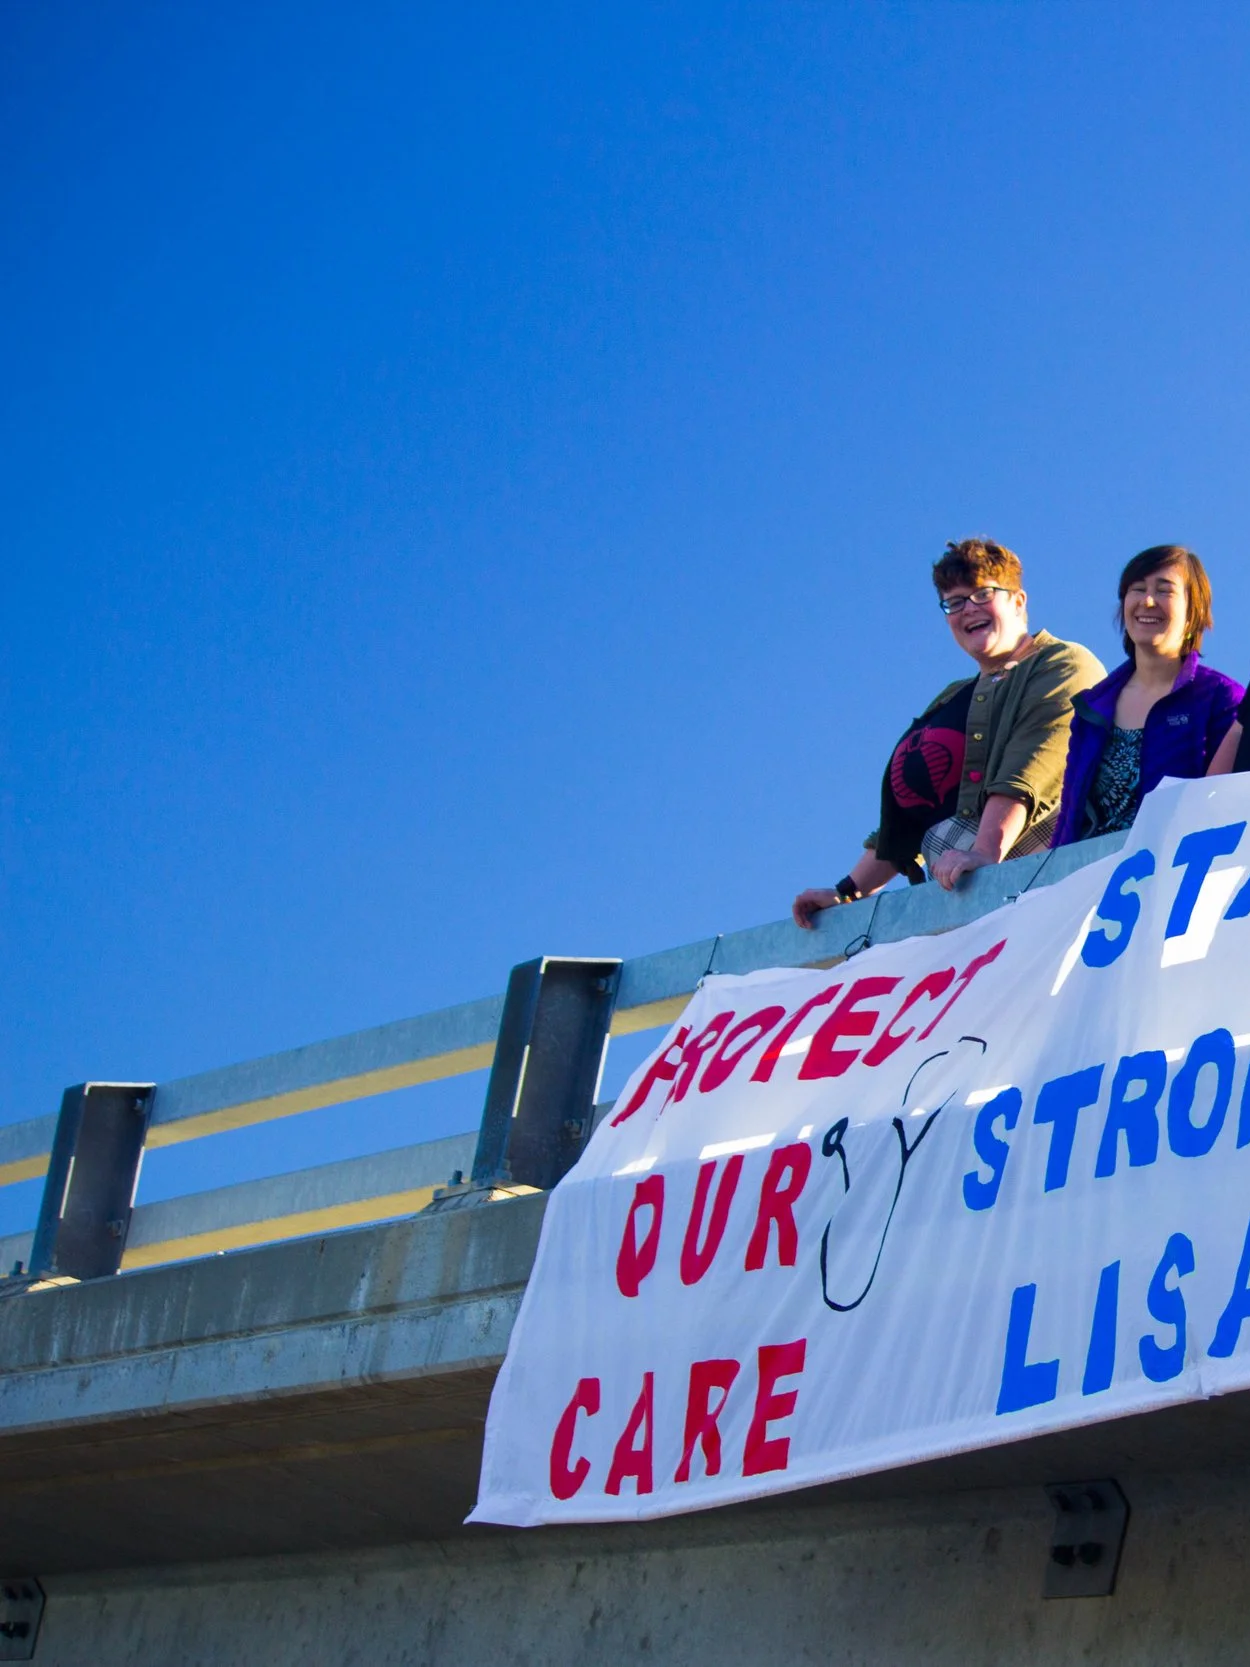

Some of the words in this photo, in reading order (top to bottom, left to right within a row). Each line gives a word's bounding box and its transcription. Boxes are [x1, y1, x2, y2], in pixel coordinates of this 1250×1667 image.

[611, 939, 1007, 1127] PROTECT
[616, 1143, 811, 1298] OUR
[550, 1340, 806, 1500] CARE
